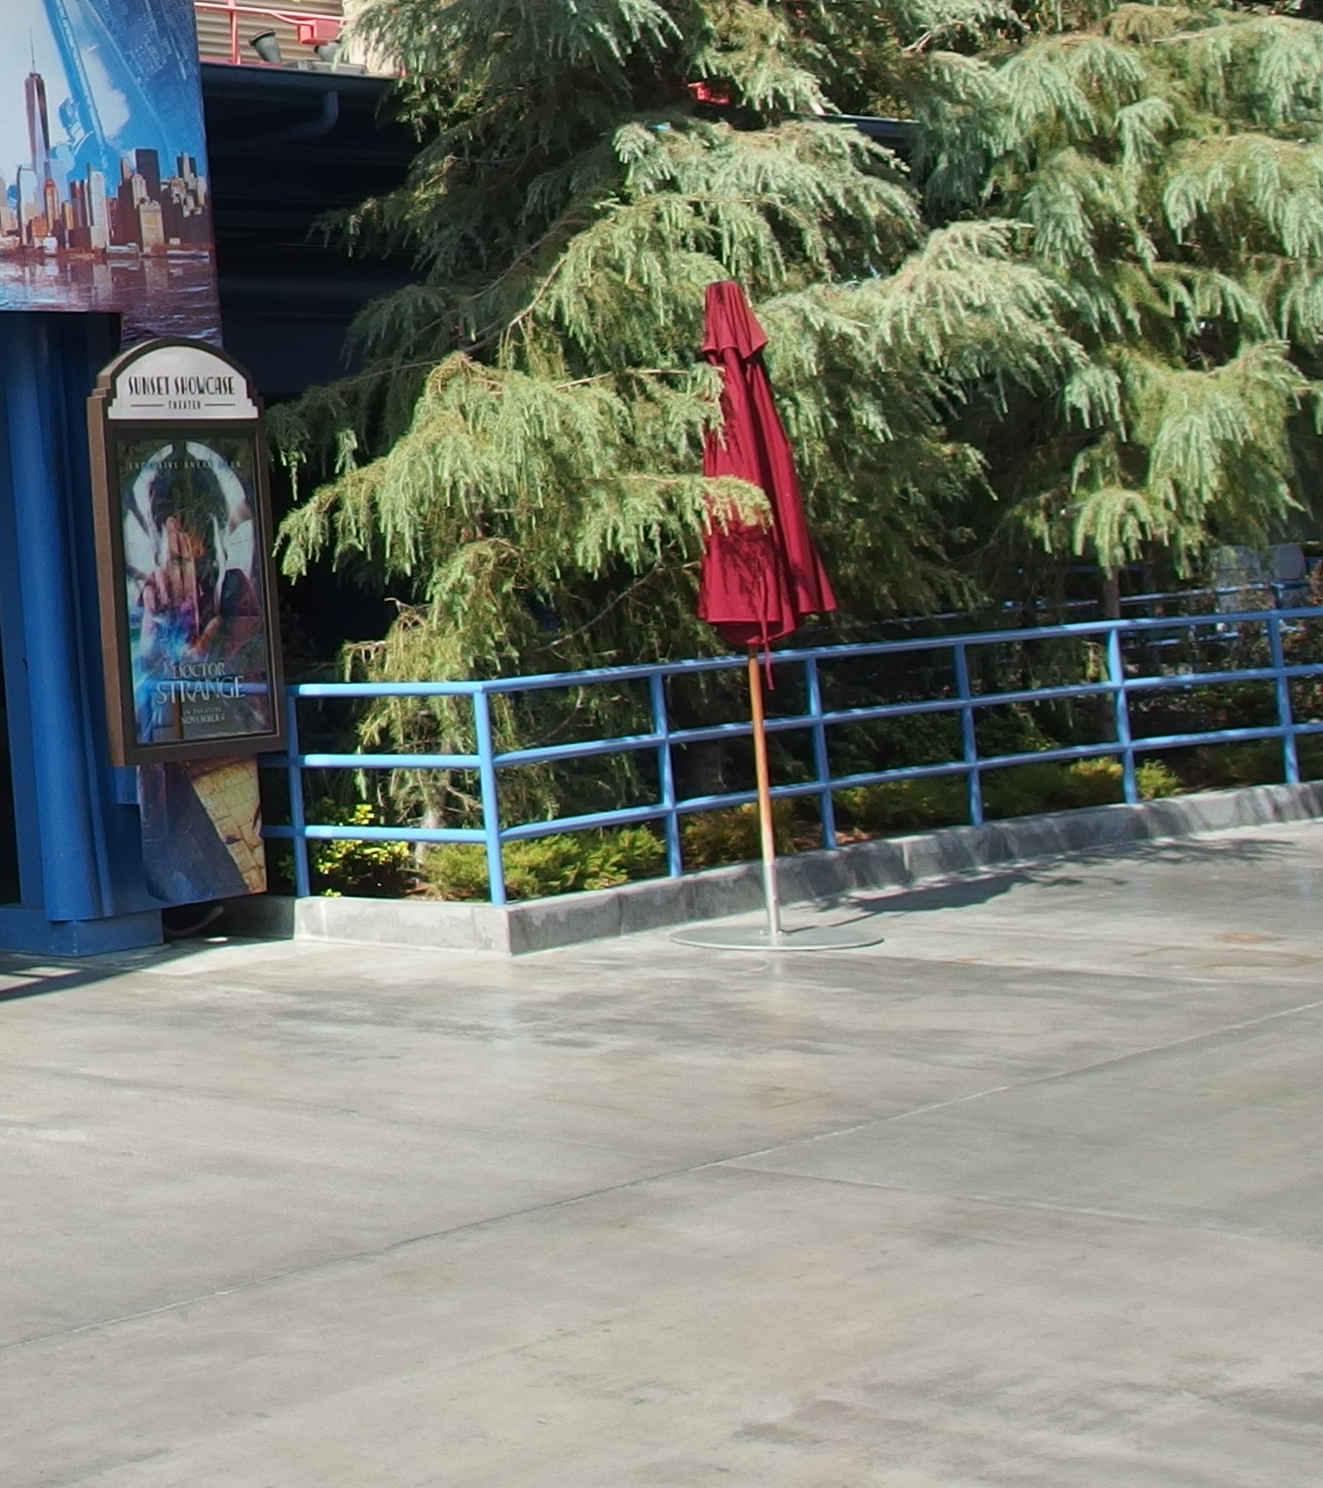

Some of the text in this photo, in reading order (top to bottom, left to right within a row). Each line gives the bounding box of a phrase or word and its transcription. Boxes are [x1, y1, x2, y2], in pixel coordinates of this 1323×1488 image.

[128, 375, 235, 396] SUNSET SHOWCASE
[168, 400, 202, 410] THEATER
[171, 662, 226, 679] DOCTOR
[155, 675, 247, 705] STRANGE
